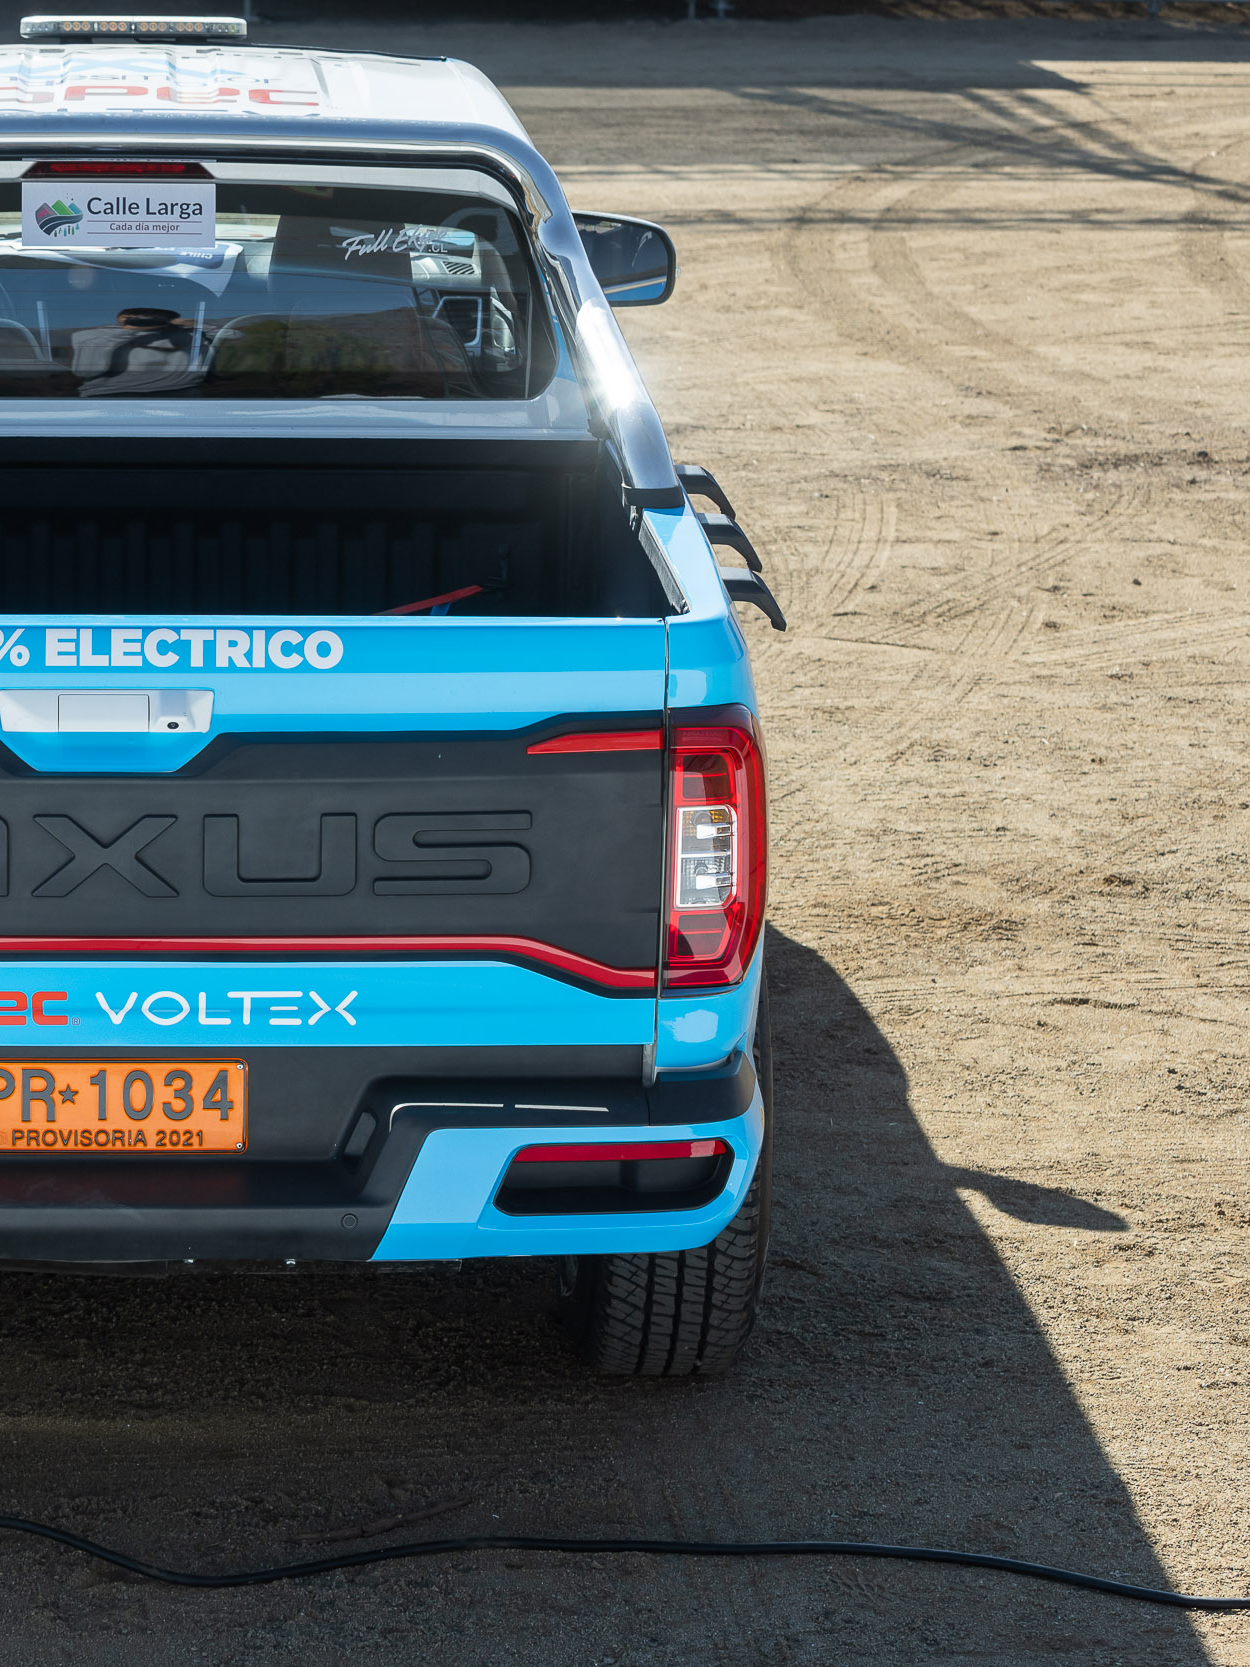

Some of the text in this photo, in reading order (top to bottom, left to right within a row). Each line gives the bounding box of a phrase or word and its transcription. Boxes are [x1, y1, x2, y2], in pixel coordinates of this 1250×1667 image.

[87, 197, 203, 219] Calle Larga
[109, 222, 180, 233] Cada día mejor
[342, 228, 392, 260] Full
[45, 627, 344, 669] ELECTRICO
[95, 990, 358, 1026] VOLTEX
[11, 1129, 204, 1148] PROVISORIA 2021
